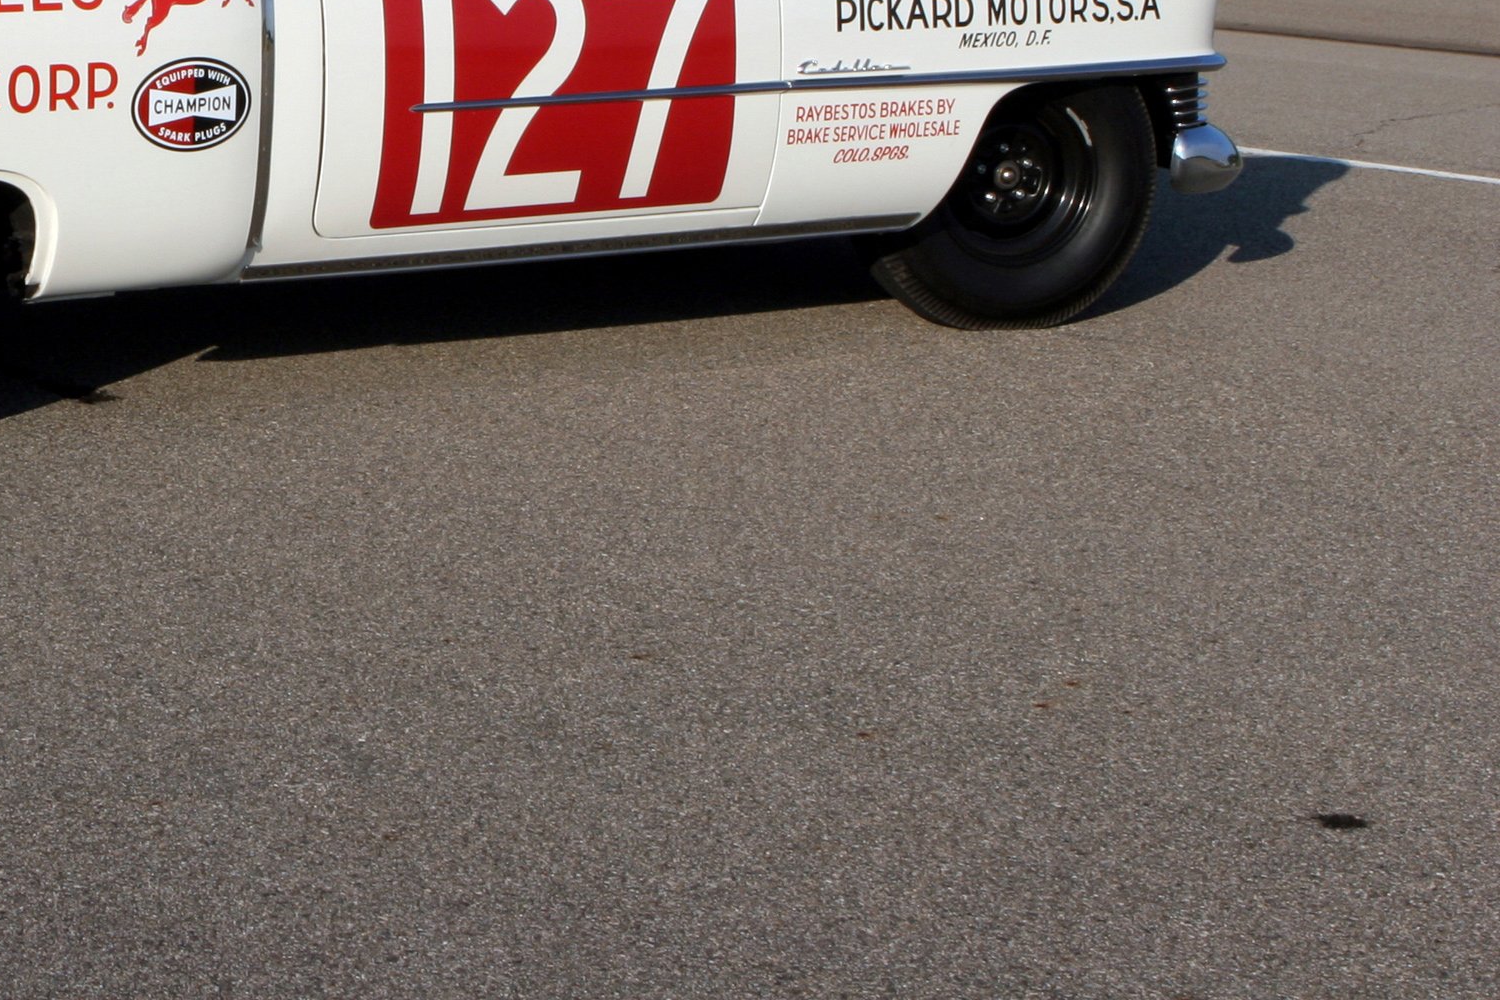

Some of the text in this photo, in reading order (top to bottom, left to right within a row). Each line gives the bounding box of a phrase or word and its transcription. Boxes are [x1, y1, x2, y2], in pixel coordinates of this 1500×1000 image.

[958, 29, 1052, 49] MEXICO, D.F.
[156, 68, 231, 89] EQUIPPED WITH
[154, 96, 231, 115] CHAMPION
[795, 98, 956, 123] RAYBESTOS BRAKES BY
[158, 122, 227, 142] SPARK PLUGS
[786, 120, 960, 145] BRAKE SERVICE WHOLESALE
